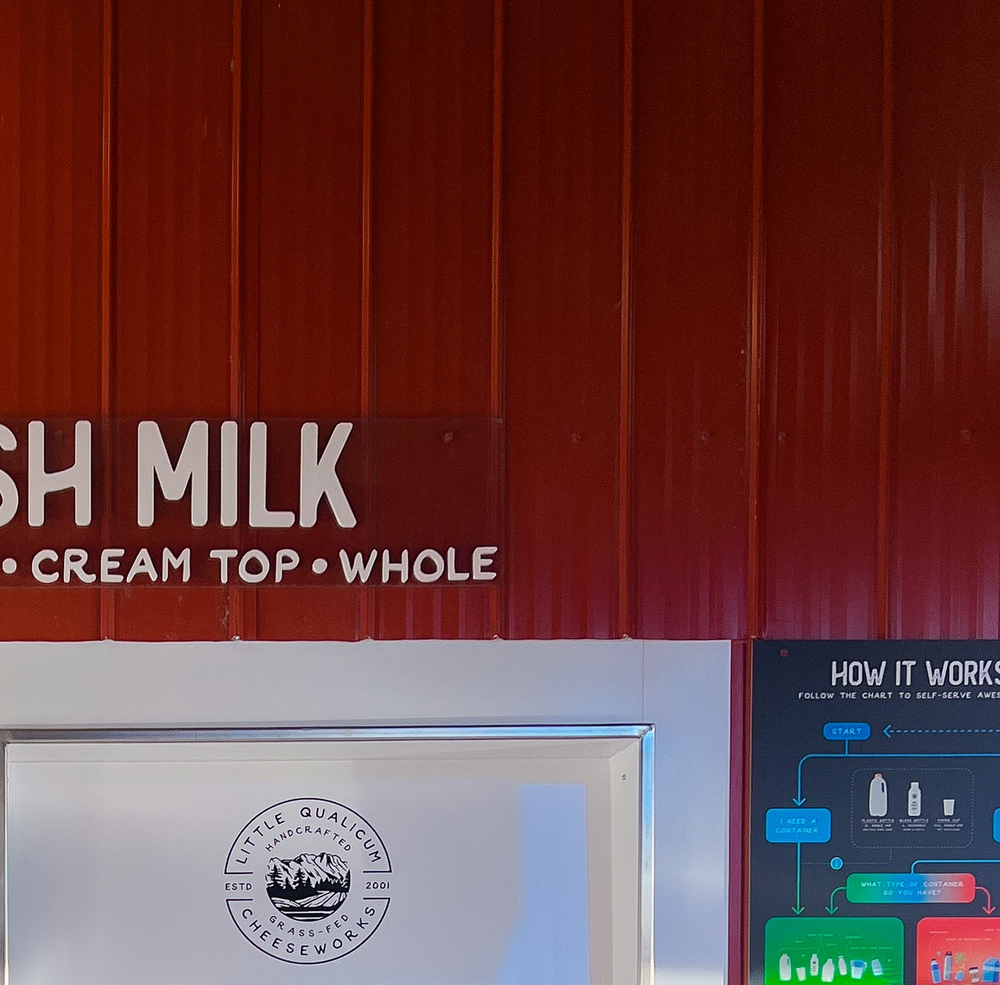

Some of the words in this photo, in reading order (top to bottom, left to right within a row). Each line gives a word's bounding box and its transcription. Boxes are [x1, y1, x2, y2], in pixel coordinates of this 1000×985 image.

[137, 420, 357, 529] MILK
[30, 547, 191, 584] CREAM
[209, 549, 300, 584] TOP
[339, 546, 499, 583] WHOLE
[831, 660, 886, 686] HOW
[895, 660, 916, 686] IT
[236, 812, 285, 864] LITTLE
[300, 806, 382, 863] QUALICUM
[265, 826, 352, 852] HANDCRAFTED
[224, 882, 252, 891] ESTD
[366, 882, 390, 890] 2001
[242, 906, 376, 956] CHEESEWORKS
[269, 914, 348, 937] GRASS-FED
